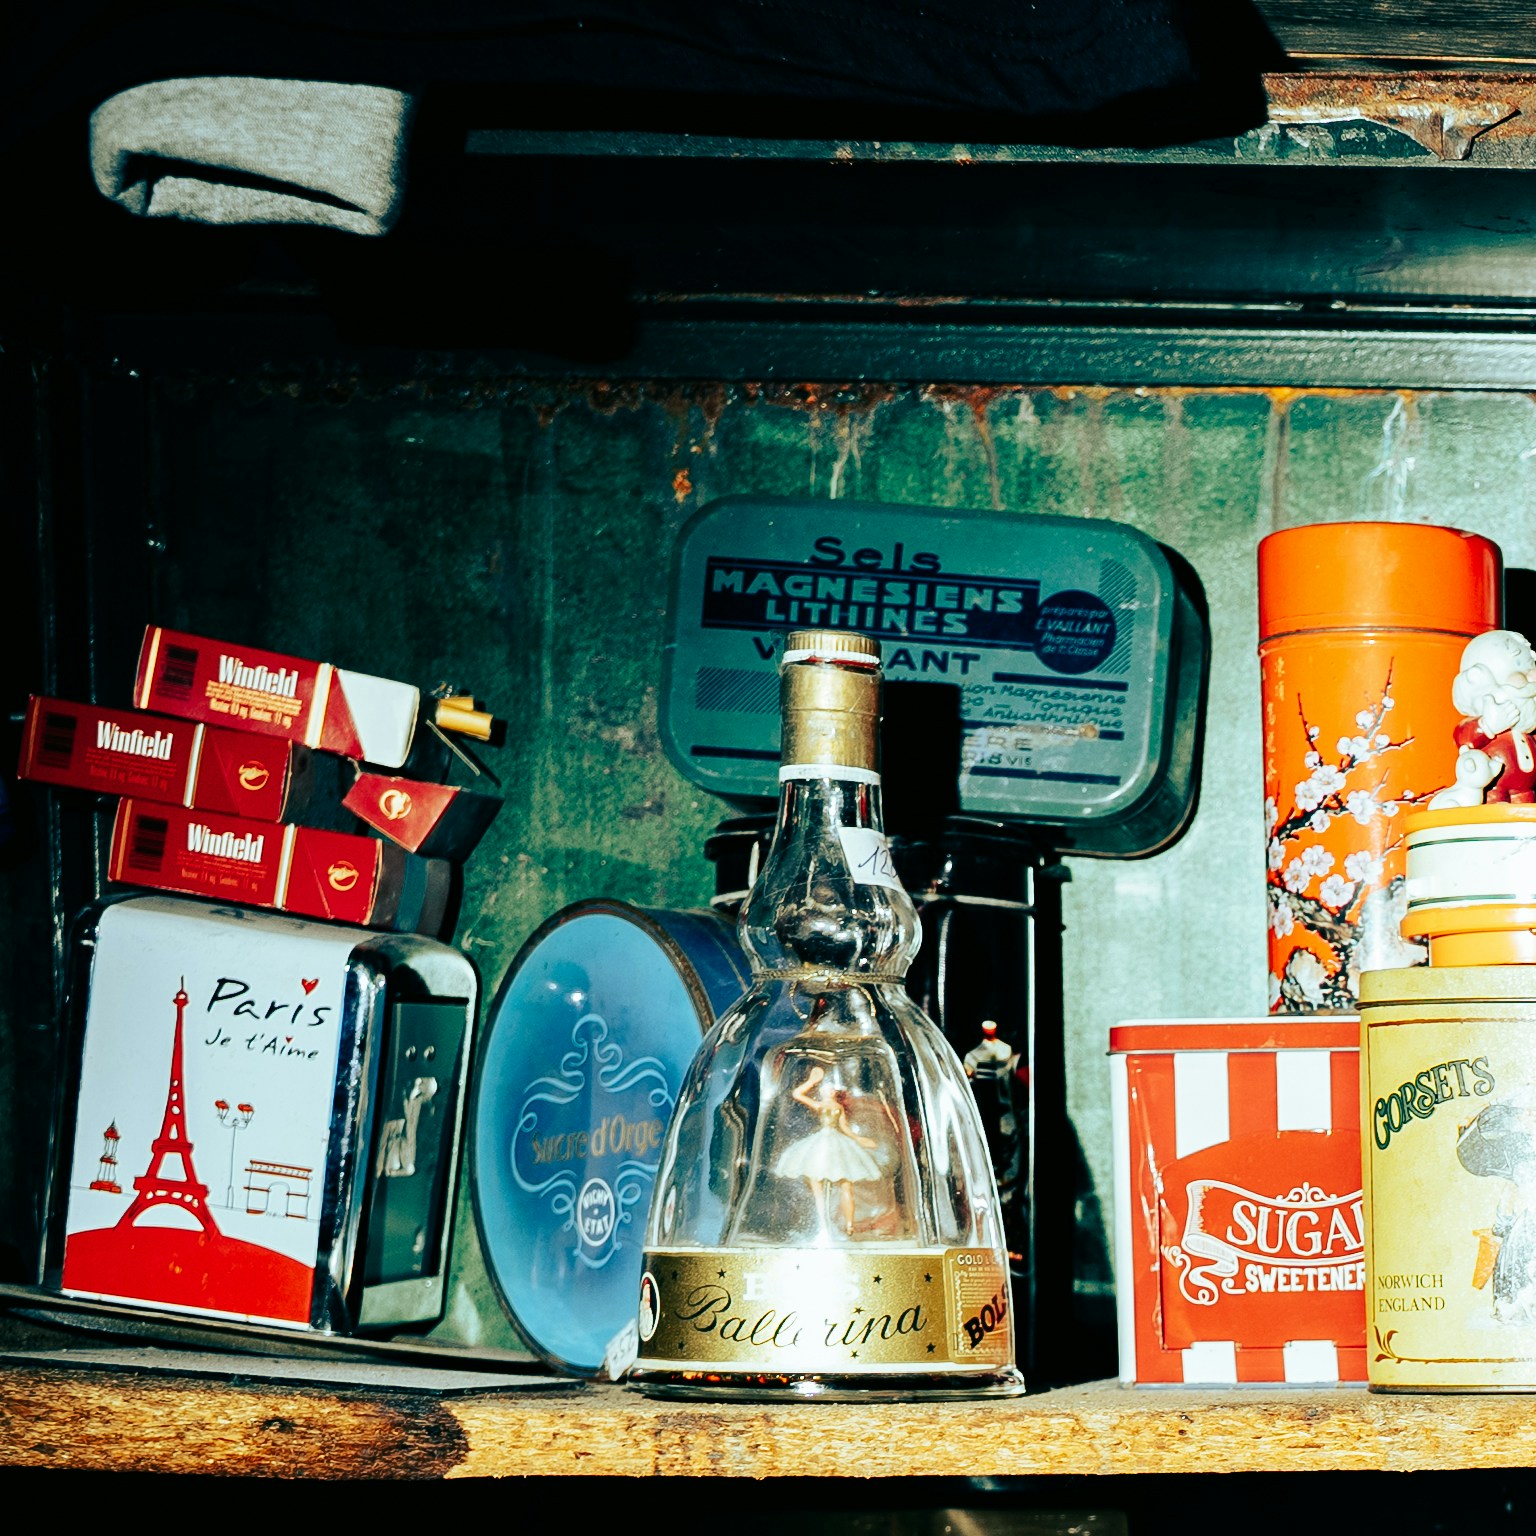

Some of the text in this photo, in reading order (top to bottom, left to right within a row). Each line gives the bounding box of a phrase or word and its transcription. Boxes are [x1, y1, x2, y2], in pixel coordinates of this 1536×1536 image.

[809, 536, 942, 574] Sels
[219, 654, 299, 697] Winfield
[96, 720, 174, 760] Winfield
[187, 822, 265, 864] Winfield
[207, 977, 332, 1027] Paris
[205, 1027, 232, 1049] Je
[1373, 1056, 1496, 1150] CORSETS
[531, 1112, 665, 1164] Sucre d'Orge
[583, 1216, 610, 1235] ETAT
[1378, 1274, 1445, 1289] NORWICH
[1379, 1296, 1446, 1312] ENGLAND
